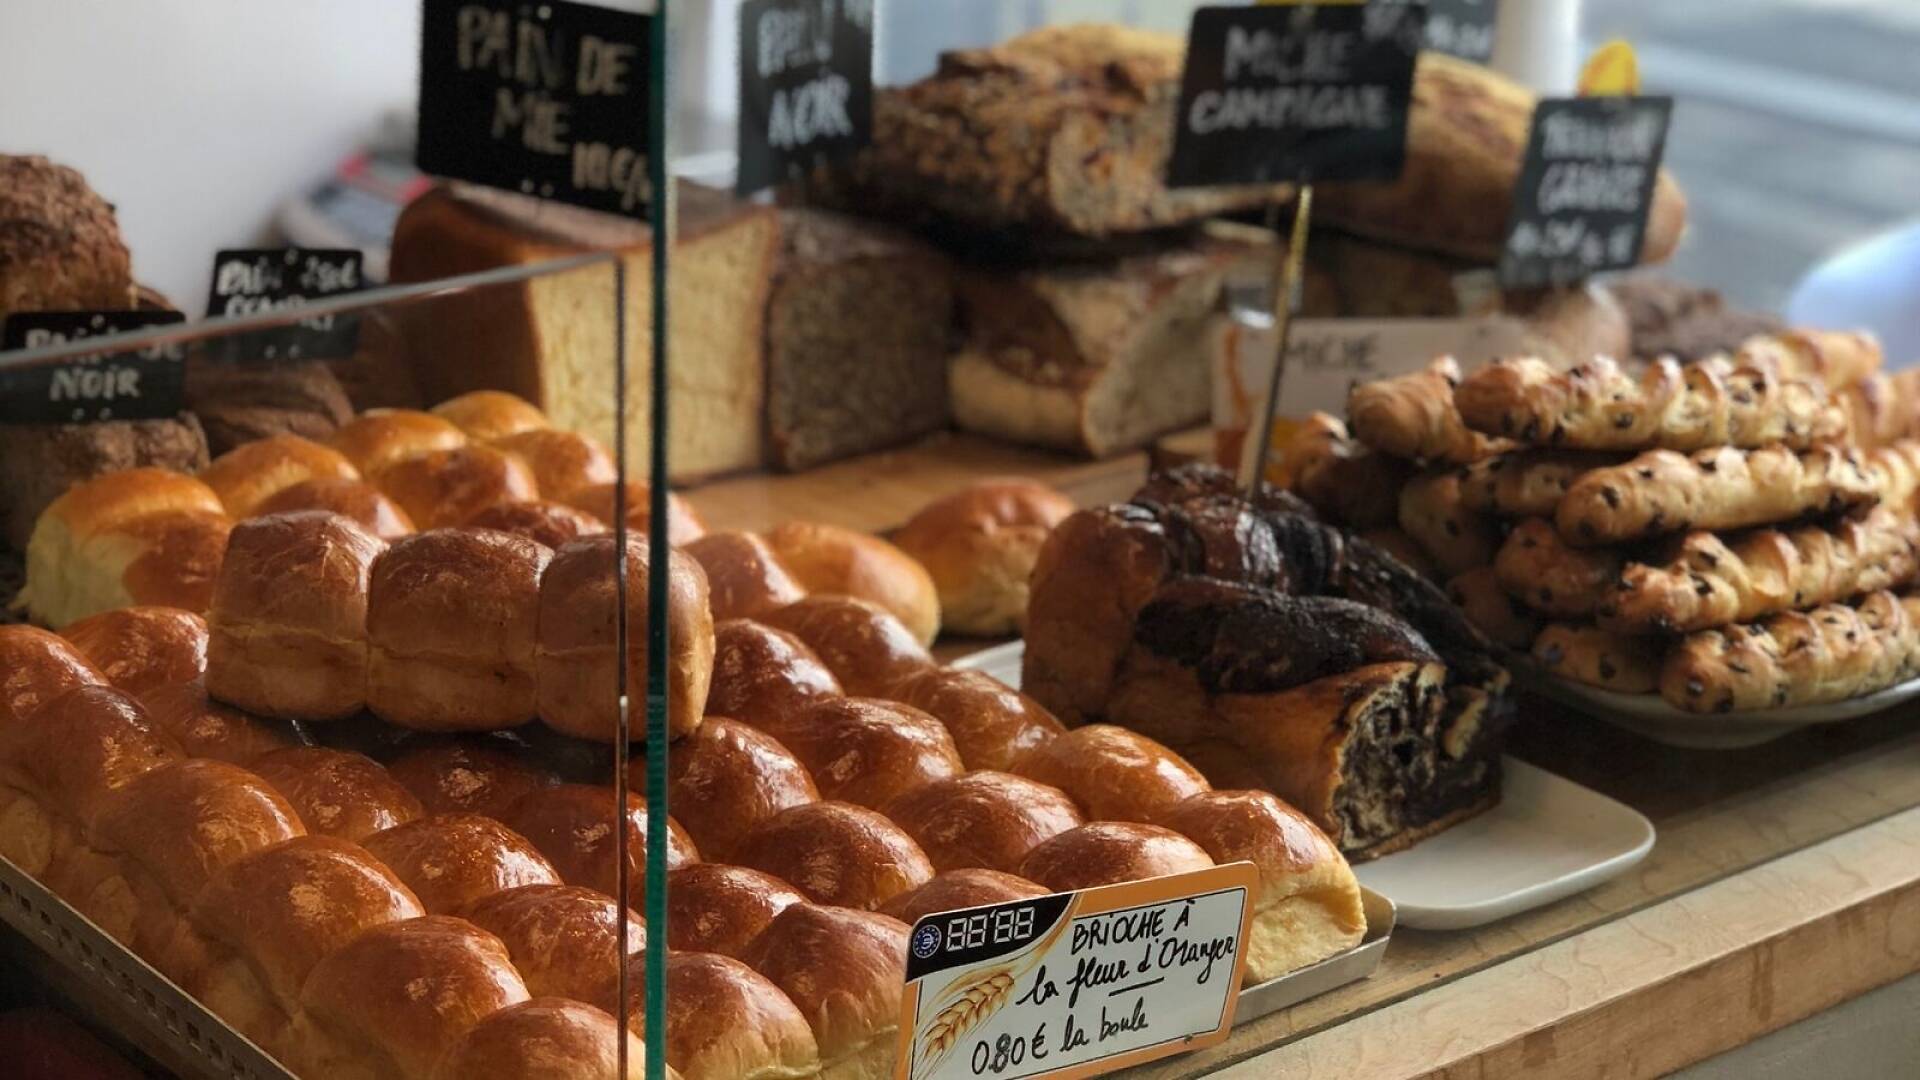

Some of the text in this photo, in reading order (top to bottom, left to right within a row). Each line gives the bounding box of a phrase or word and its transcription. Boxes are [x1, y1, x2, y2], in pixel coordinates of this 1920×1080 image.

[576, 34, 638, 96] DE
[50, 363, 142, 400] NOIR
[1015, 964, 1060, 1006] la
[1066, 956, 1131, 1009] fleur
[1059, 1014, 1091, 1052] la
[1098, 995, 1149, 1042] boule
